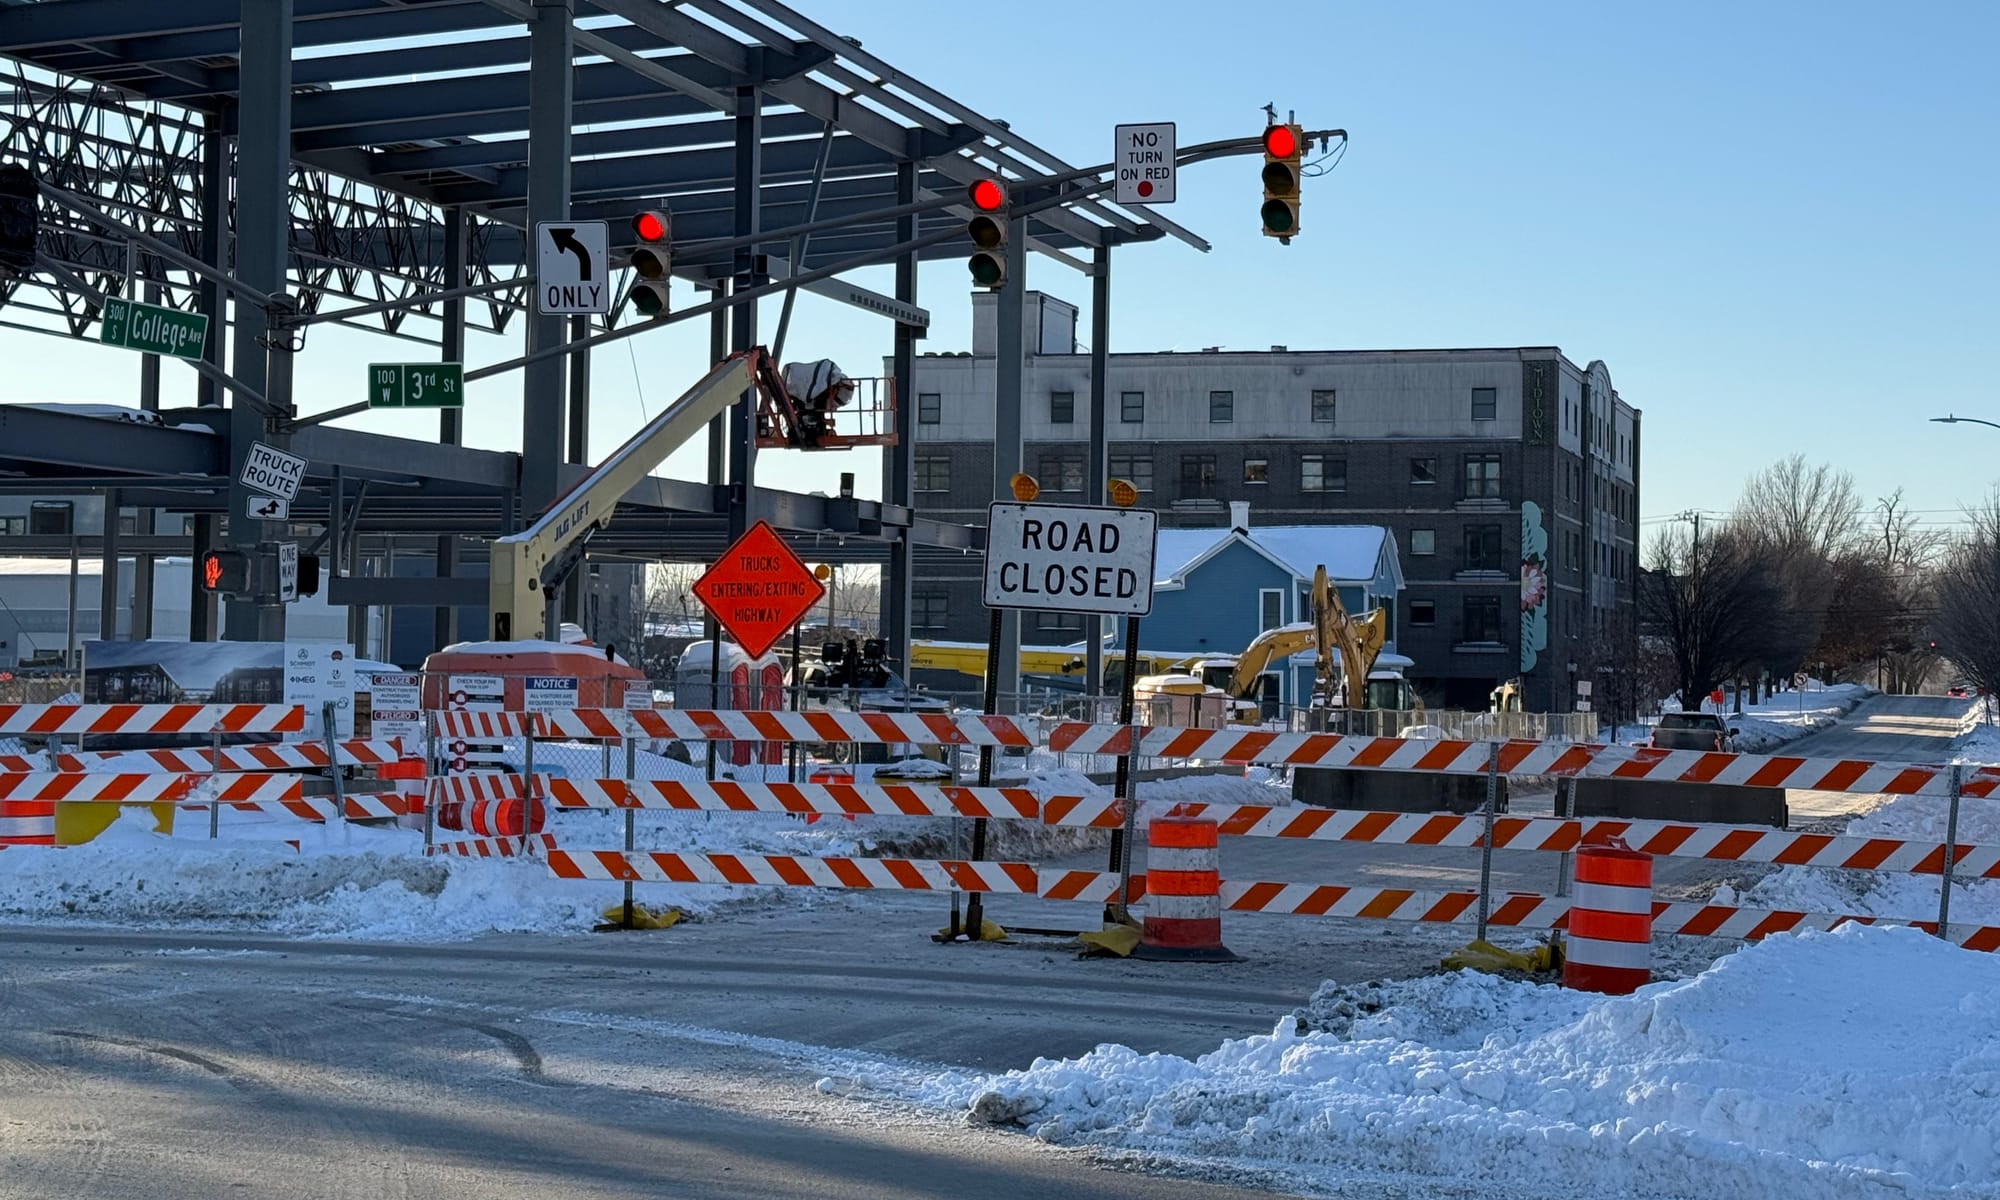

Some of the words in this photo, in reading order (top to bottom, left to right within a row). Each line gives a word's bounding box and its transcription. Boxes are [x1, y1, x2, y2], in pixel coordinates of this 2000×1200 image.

[1133, 132, 1158, 147] NO
[1128, 151, 1162, 164] TURN
[1121, 168, 1138, 181] ON
[1145, 167, 1170, 180] RED
[548, 285, 600, 308] ONLY
[109, 304, 124, 321] 300
[112, 325, 117, 340] S
[133, 311, 187, 354] College
[188, 328, 202, 343] Ave
[377, 370, 395, 384] 100
[412, 371, 436, 400] 3rd
[443, 378, 455, 393] St
[382, 388, 391, 402] W
[254, 449, 301, 477] TRUCK
[247, 466, 295, 494] ROUTE
[554, 518, 570, 542] JLG
[572, 501, 590, 526] LIFT
[1022, 520, 1120, 553] ROAD
[282, 548, 295, 561] ONE
[282, 564, 296, 578] WAY
[740, 556, 780, 571] TRUCKS
[1000, 562, 1137, 599] CLOSED
[711, 582, 805, 598] ENTERING/EXITING
[734, 608, 781, 622] HIGHWAY
[533, 679, 570, 688] NOTICE
